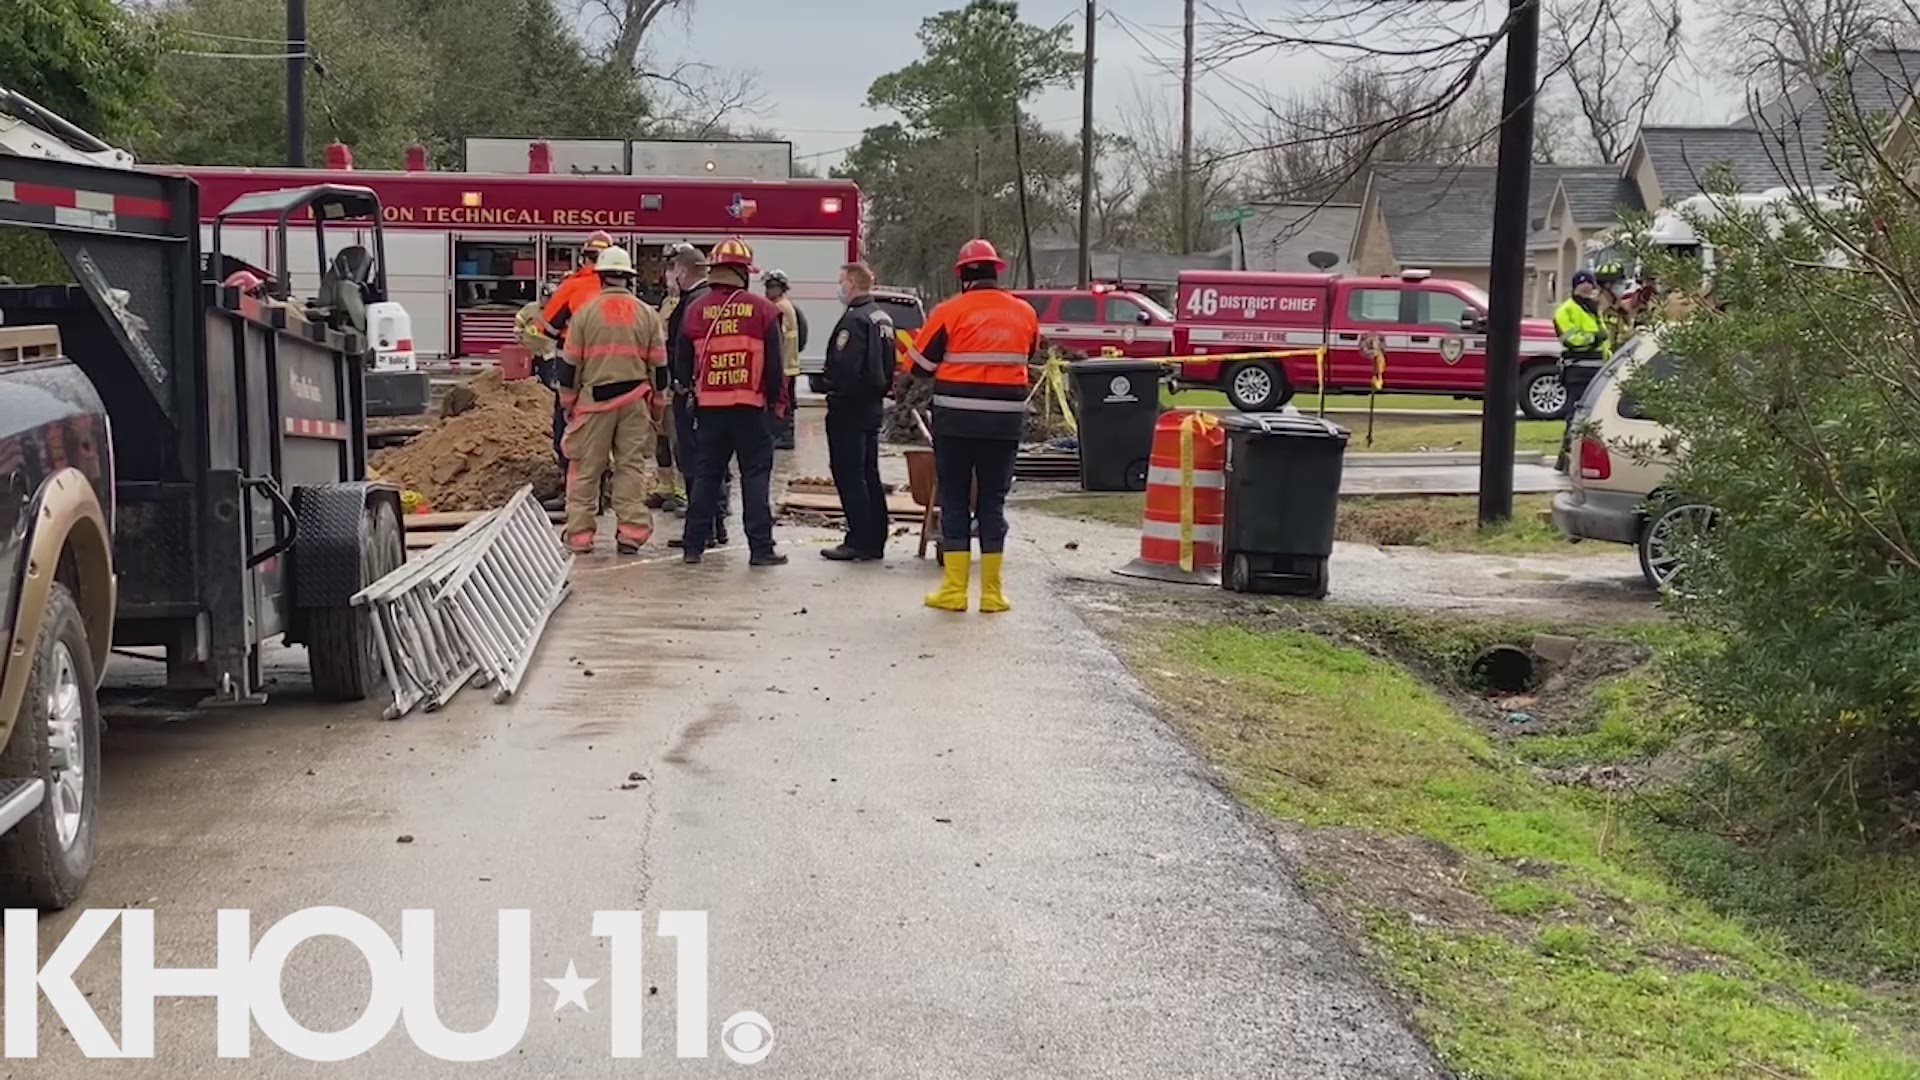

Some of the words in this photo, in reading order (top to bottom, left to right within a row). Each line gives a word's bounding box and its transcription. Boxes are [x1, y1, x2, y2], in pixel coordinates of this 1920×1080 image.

[422, 206, 545, 224] TECHNICAL
[552, 209, 636, 226] RESCUE
[1186, 288, 1218, 316] 46
[1219, 295, 1276, 311] DISTRICT
[1279, 298, 1317, 312] CHIEF
[703, 303, 753, 319] HOUSTON
[715, 319, 739, 335] FIRE
[1222, 331, 1264, 341] HOUSTON
[1267, 332, 1286, 342] FIRE
[710, 352, 747, 369] SAFETY
[707, 370, 749, 385] OFFICER
